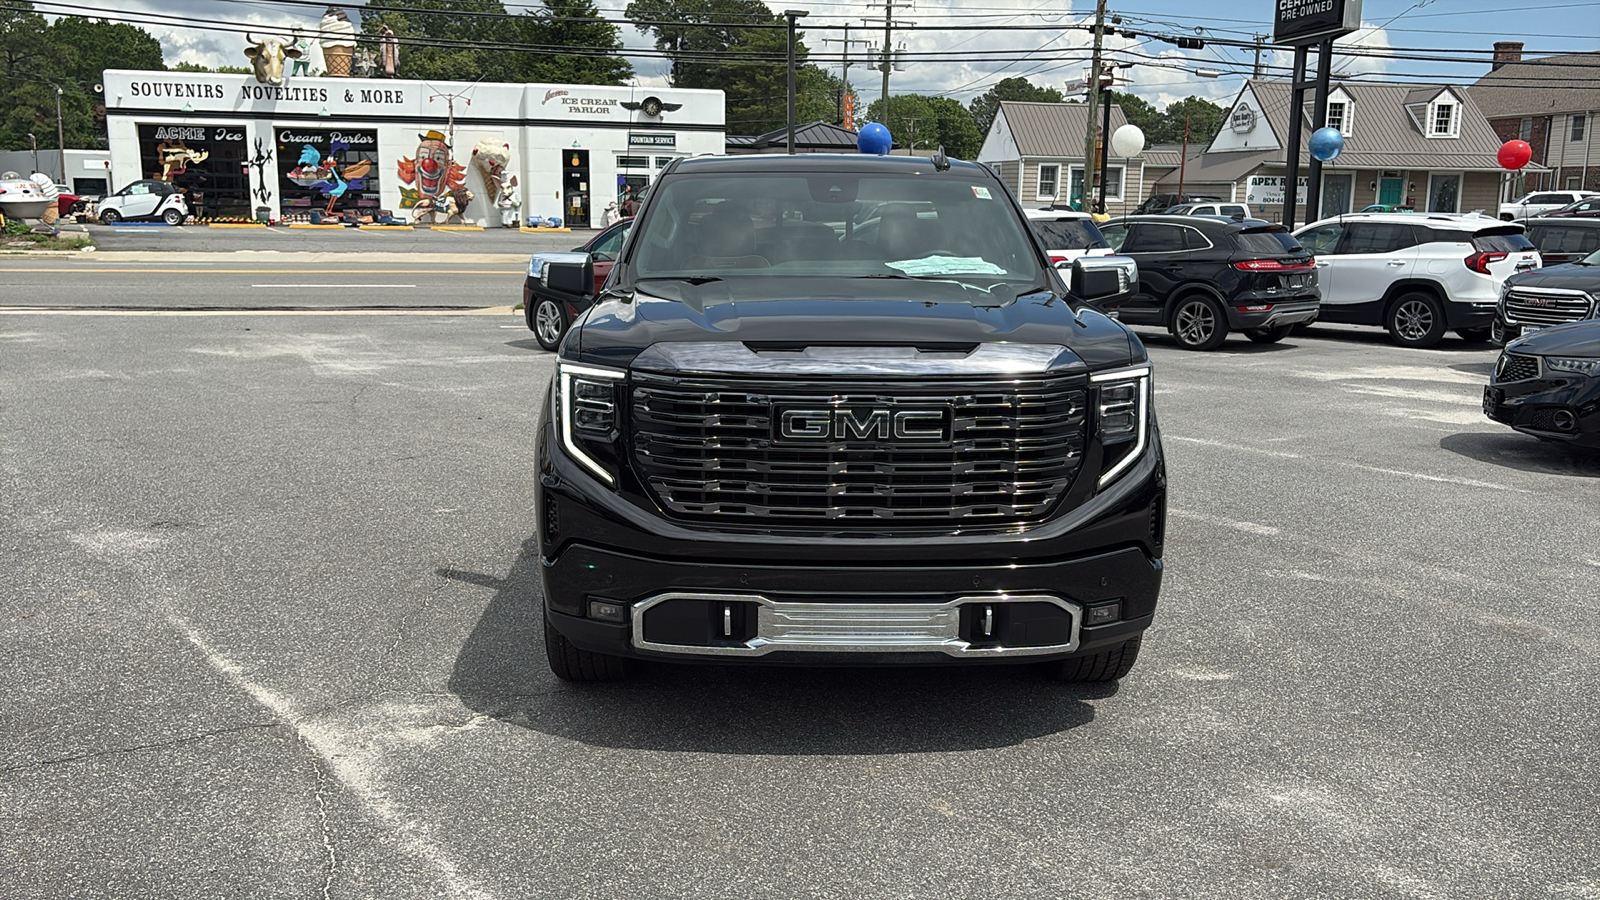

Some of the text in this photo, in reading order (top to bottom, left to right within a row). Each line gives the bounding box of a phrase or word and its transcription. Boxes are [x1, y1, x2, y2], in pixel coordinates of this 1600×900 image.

[1281, 0, 1333, 21] PRE-OWNED
[131, 82, 404, 104] SOUVENIRS NOVELTIES & MORE
[580, 98, 618, 106] CREAM
[568, 106, 610, 114] PARLOR
[155, 127, 243, 141] ACME Ice
[280, 130, 375, 144] Cream Parlor
[630, 136, 654, 144] FOUNTAIN
[1251, 177, 1277, 186] APEX
[1523, 297, 1556, 308] GMC
[781, 410, 943, 439] GMC
